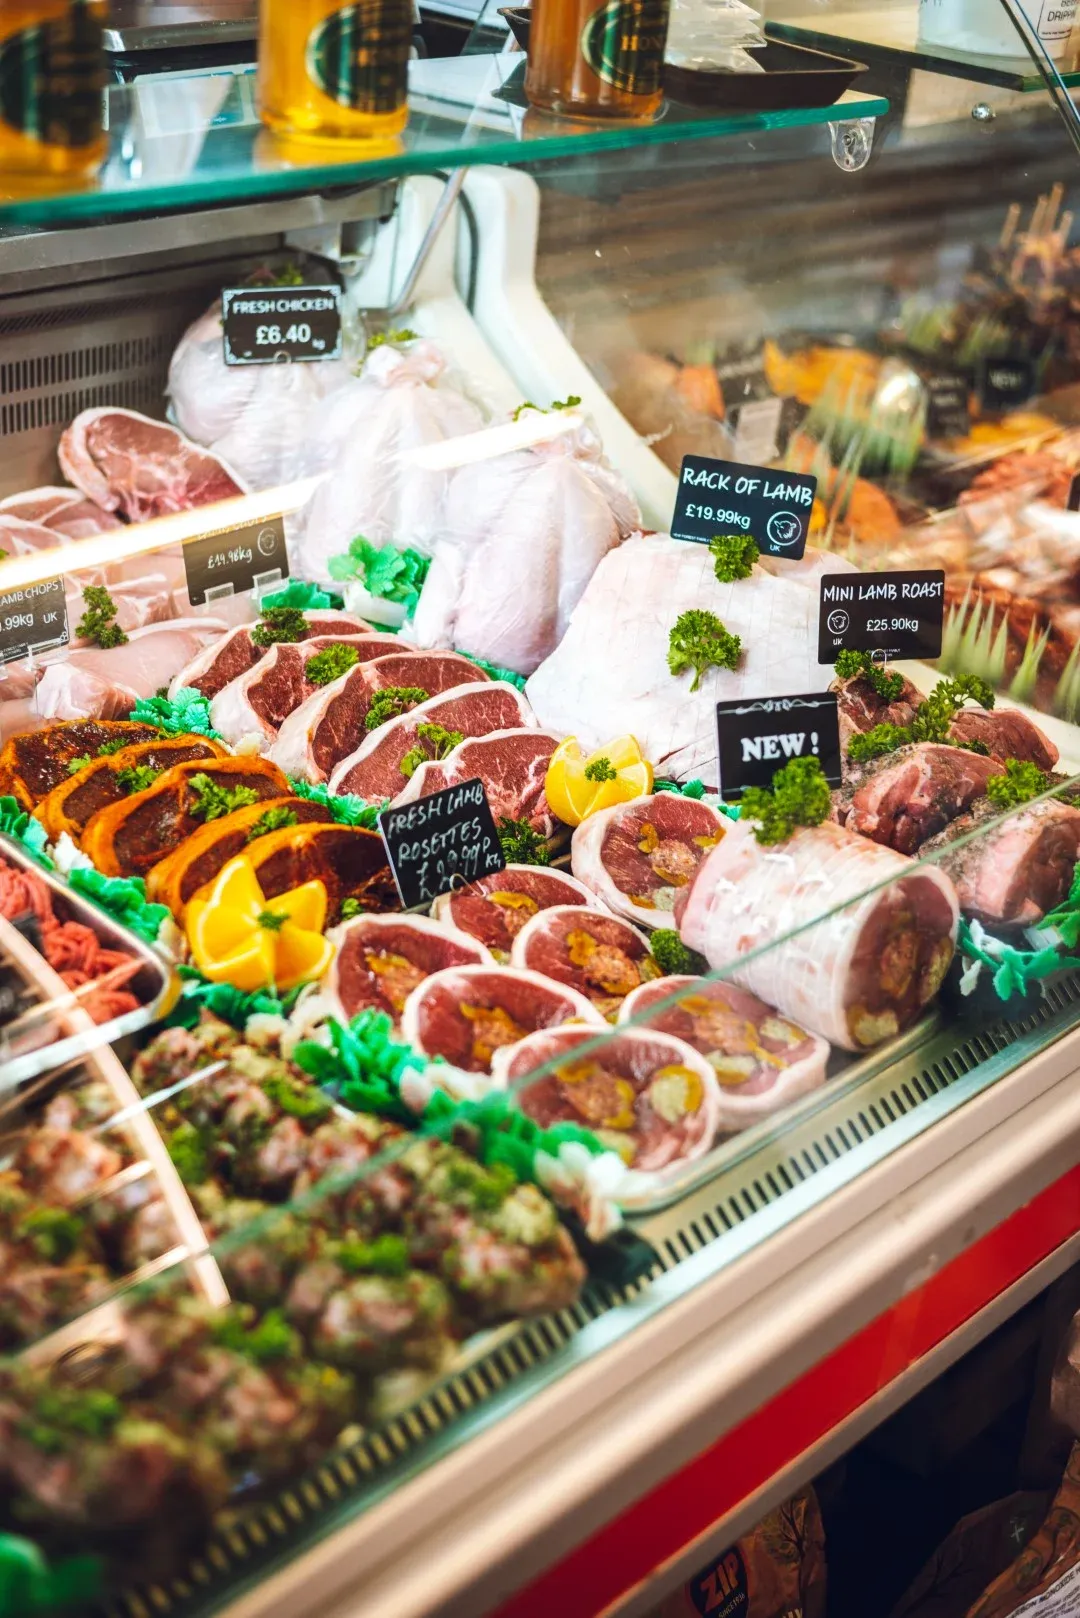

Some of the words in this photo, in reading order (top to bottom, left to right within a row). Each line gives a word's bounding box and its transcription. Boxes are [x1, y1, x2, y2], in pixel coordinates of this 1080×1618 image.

[232, 300, 275, 314] FRESH
[276, 297, 334, 313] CHICKEN
[255, 323, 312, 345] £6.40
[682, 467, 731, 491] RACK
[734, 476, 761, 495] OF
[763, 481, 813, 506] LAMB
[685, 503, 751, 530] £19.99kg
[769, 544, 781, 552] UK
[0, 591, 24, 606] AMB
[24, 580, 59, 599] CHOPS
[823, 585, 854, 602] MINI
[858, 583, 898, 601] LAMB
[901, 582, 944, 599] ROAST
[0, 612, 34, 632] .99kg
[43, 611, 58, 624] UK
[866, 618, 919, 632] £25.90kg
[832, 638, 843, 646] UK
[387, 797, 442, 839] FRESH
[447, 783, 484, 815] LAMB
[398, 816, 482, 868] ROSETTES
[700, 1552, 740, 1614] ZIP
